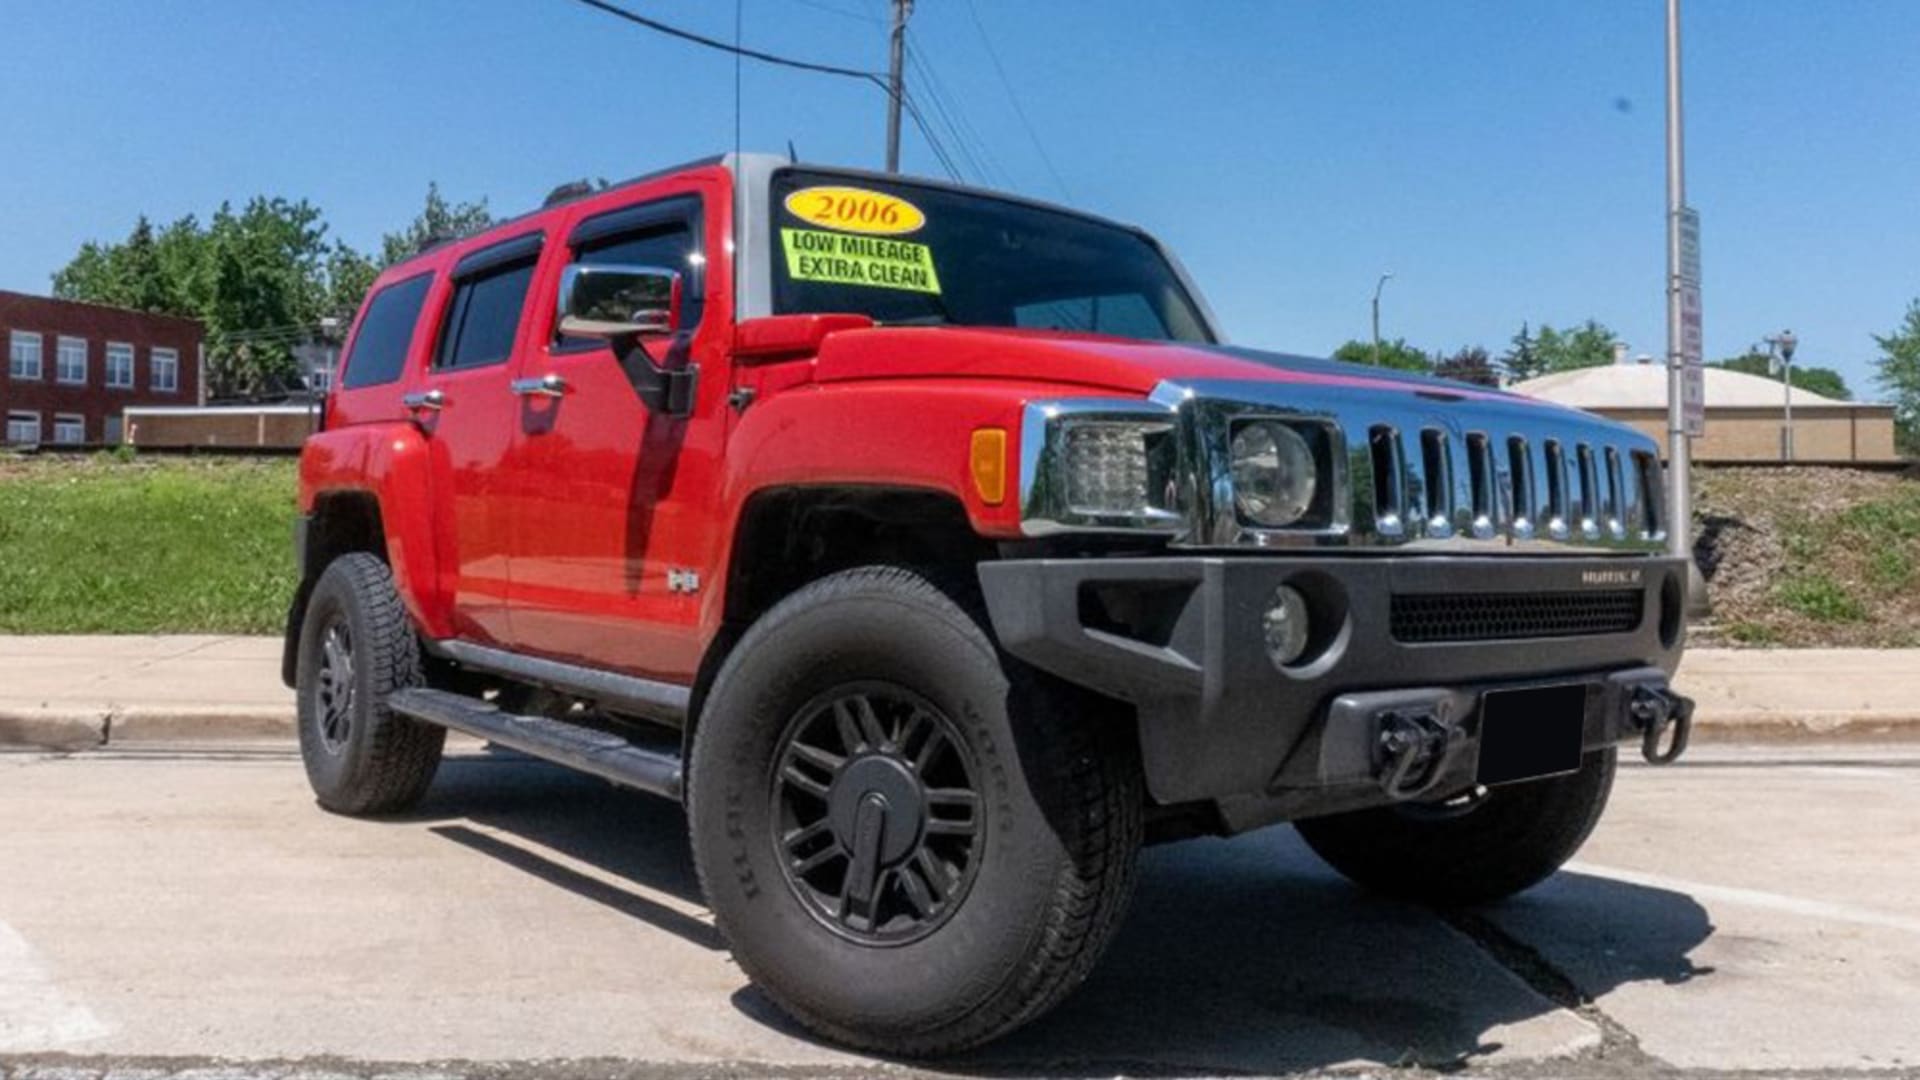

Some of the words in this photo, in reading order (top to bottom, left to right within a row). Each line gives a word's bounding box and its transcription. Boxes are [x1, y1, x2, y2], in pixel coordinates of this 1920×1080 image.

[814, 196, 899, 225] 2006
[793, 232, 835, 252] LOW
[841, 237, 923, 263] MILEAGE
[799, 256, 864, 279] EXTRA
[868, 262, 928, 286] CLEAN
